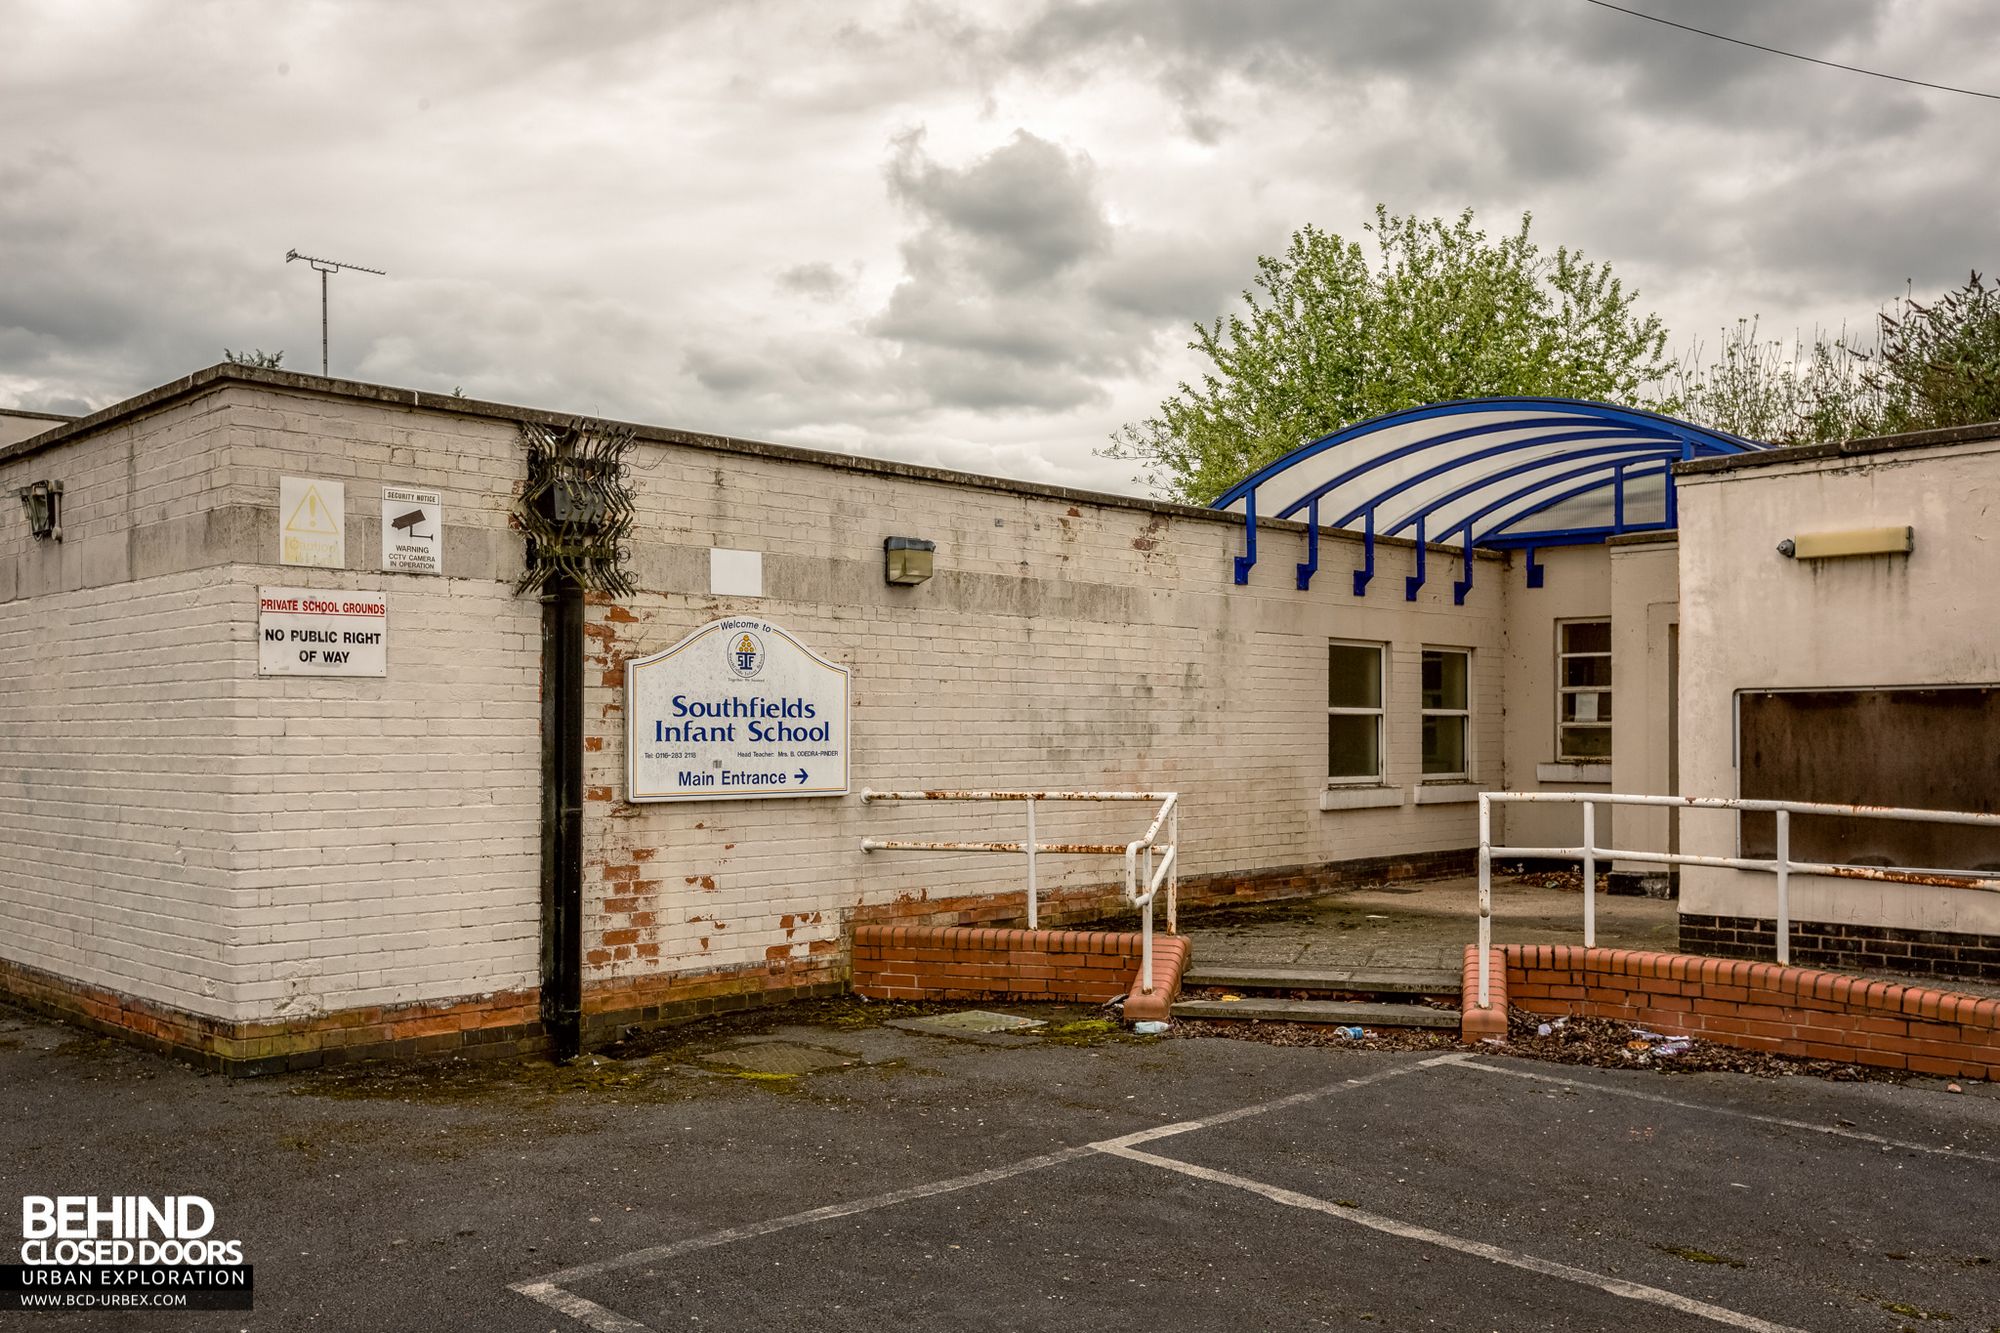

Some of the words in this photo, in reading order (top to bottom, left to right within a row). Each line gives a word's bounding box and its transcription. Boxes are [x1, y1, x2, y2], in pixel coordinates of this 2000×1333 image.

[387, 491, 415, 500] SECURITY
[416, 494, 436, 503] NOTICE
[395, 545, 430, 554] WARNING
[388, 553, 407, 561] CCTV
[408, 554, 436, 563] CAMERA
[398, 561, 435, 569] OPERATION
[261, 599, 298, 612] PRIVATE
[302, 601, 339, 613] SCHOOL
[342, 603, 385, 615] GROUNDS
[720, 620, 759, 630] Welcome
[762, 624, 771, 633] to
[265, 629, 285, 642] NO
[290, 630, 338, 643] PUBLIC
[343, 632, 381, 645] RIGHT
[299, 651, 318, 663] OF
[323, 651, 350, 663] WAY
[672, 695, 816, 718] Southfields
[655, 720, 736, 742] Infant
[748, 720, 830, 742] School
[678, 771, 715, 786] Main
[721, 770, 787, 786] Entrance
